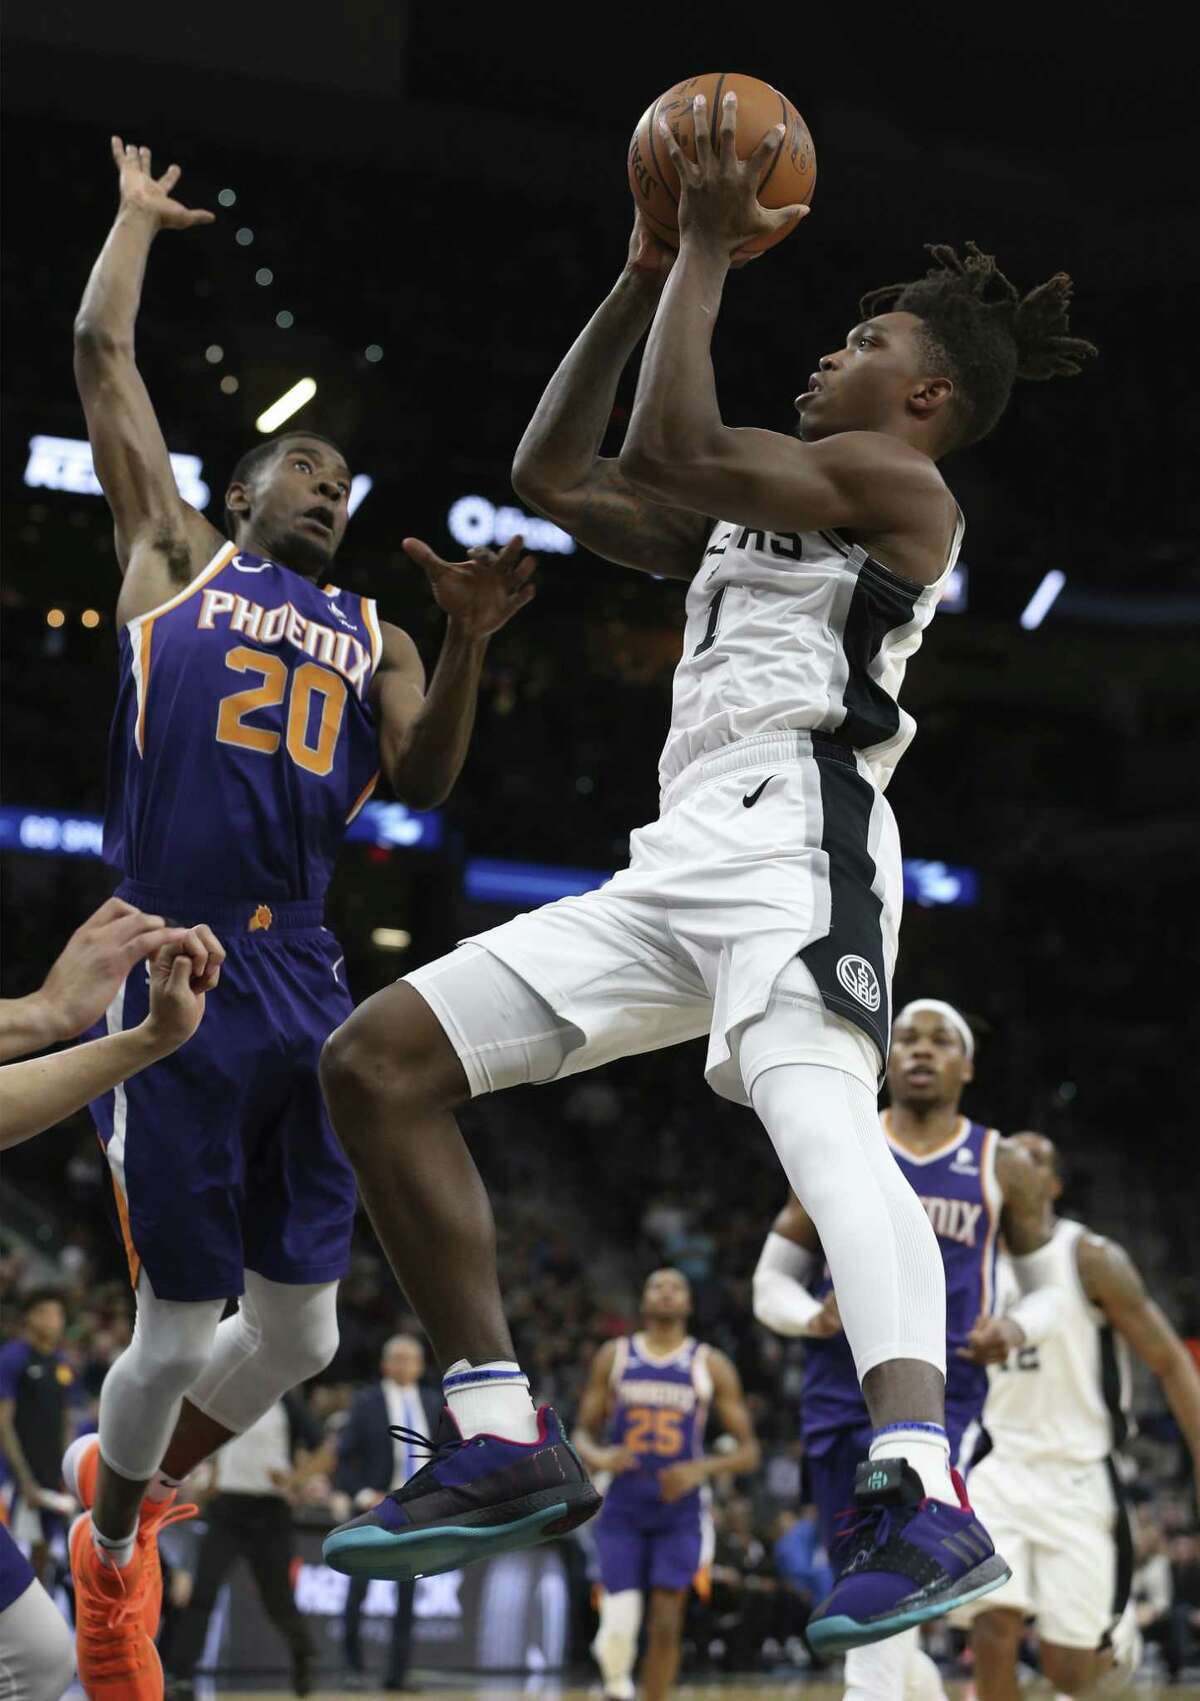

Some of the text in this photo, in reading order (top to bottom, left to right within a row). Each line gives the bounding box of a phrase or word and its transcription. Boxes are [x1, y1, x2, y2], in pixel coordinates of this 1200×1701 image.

[197, 588, 372, 701] PHOENIX
[216, 645, 348, 777] 20
[919, 1195, 982, 1248] NIX
[624, 1406, 684, 1457] 25
